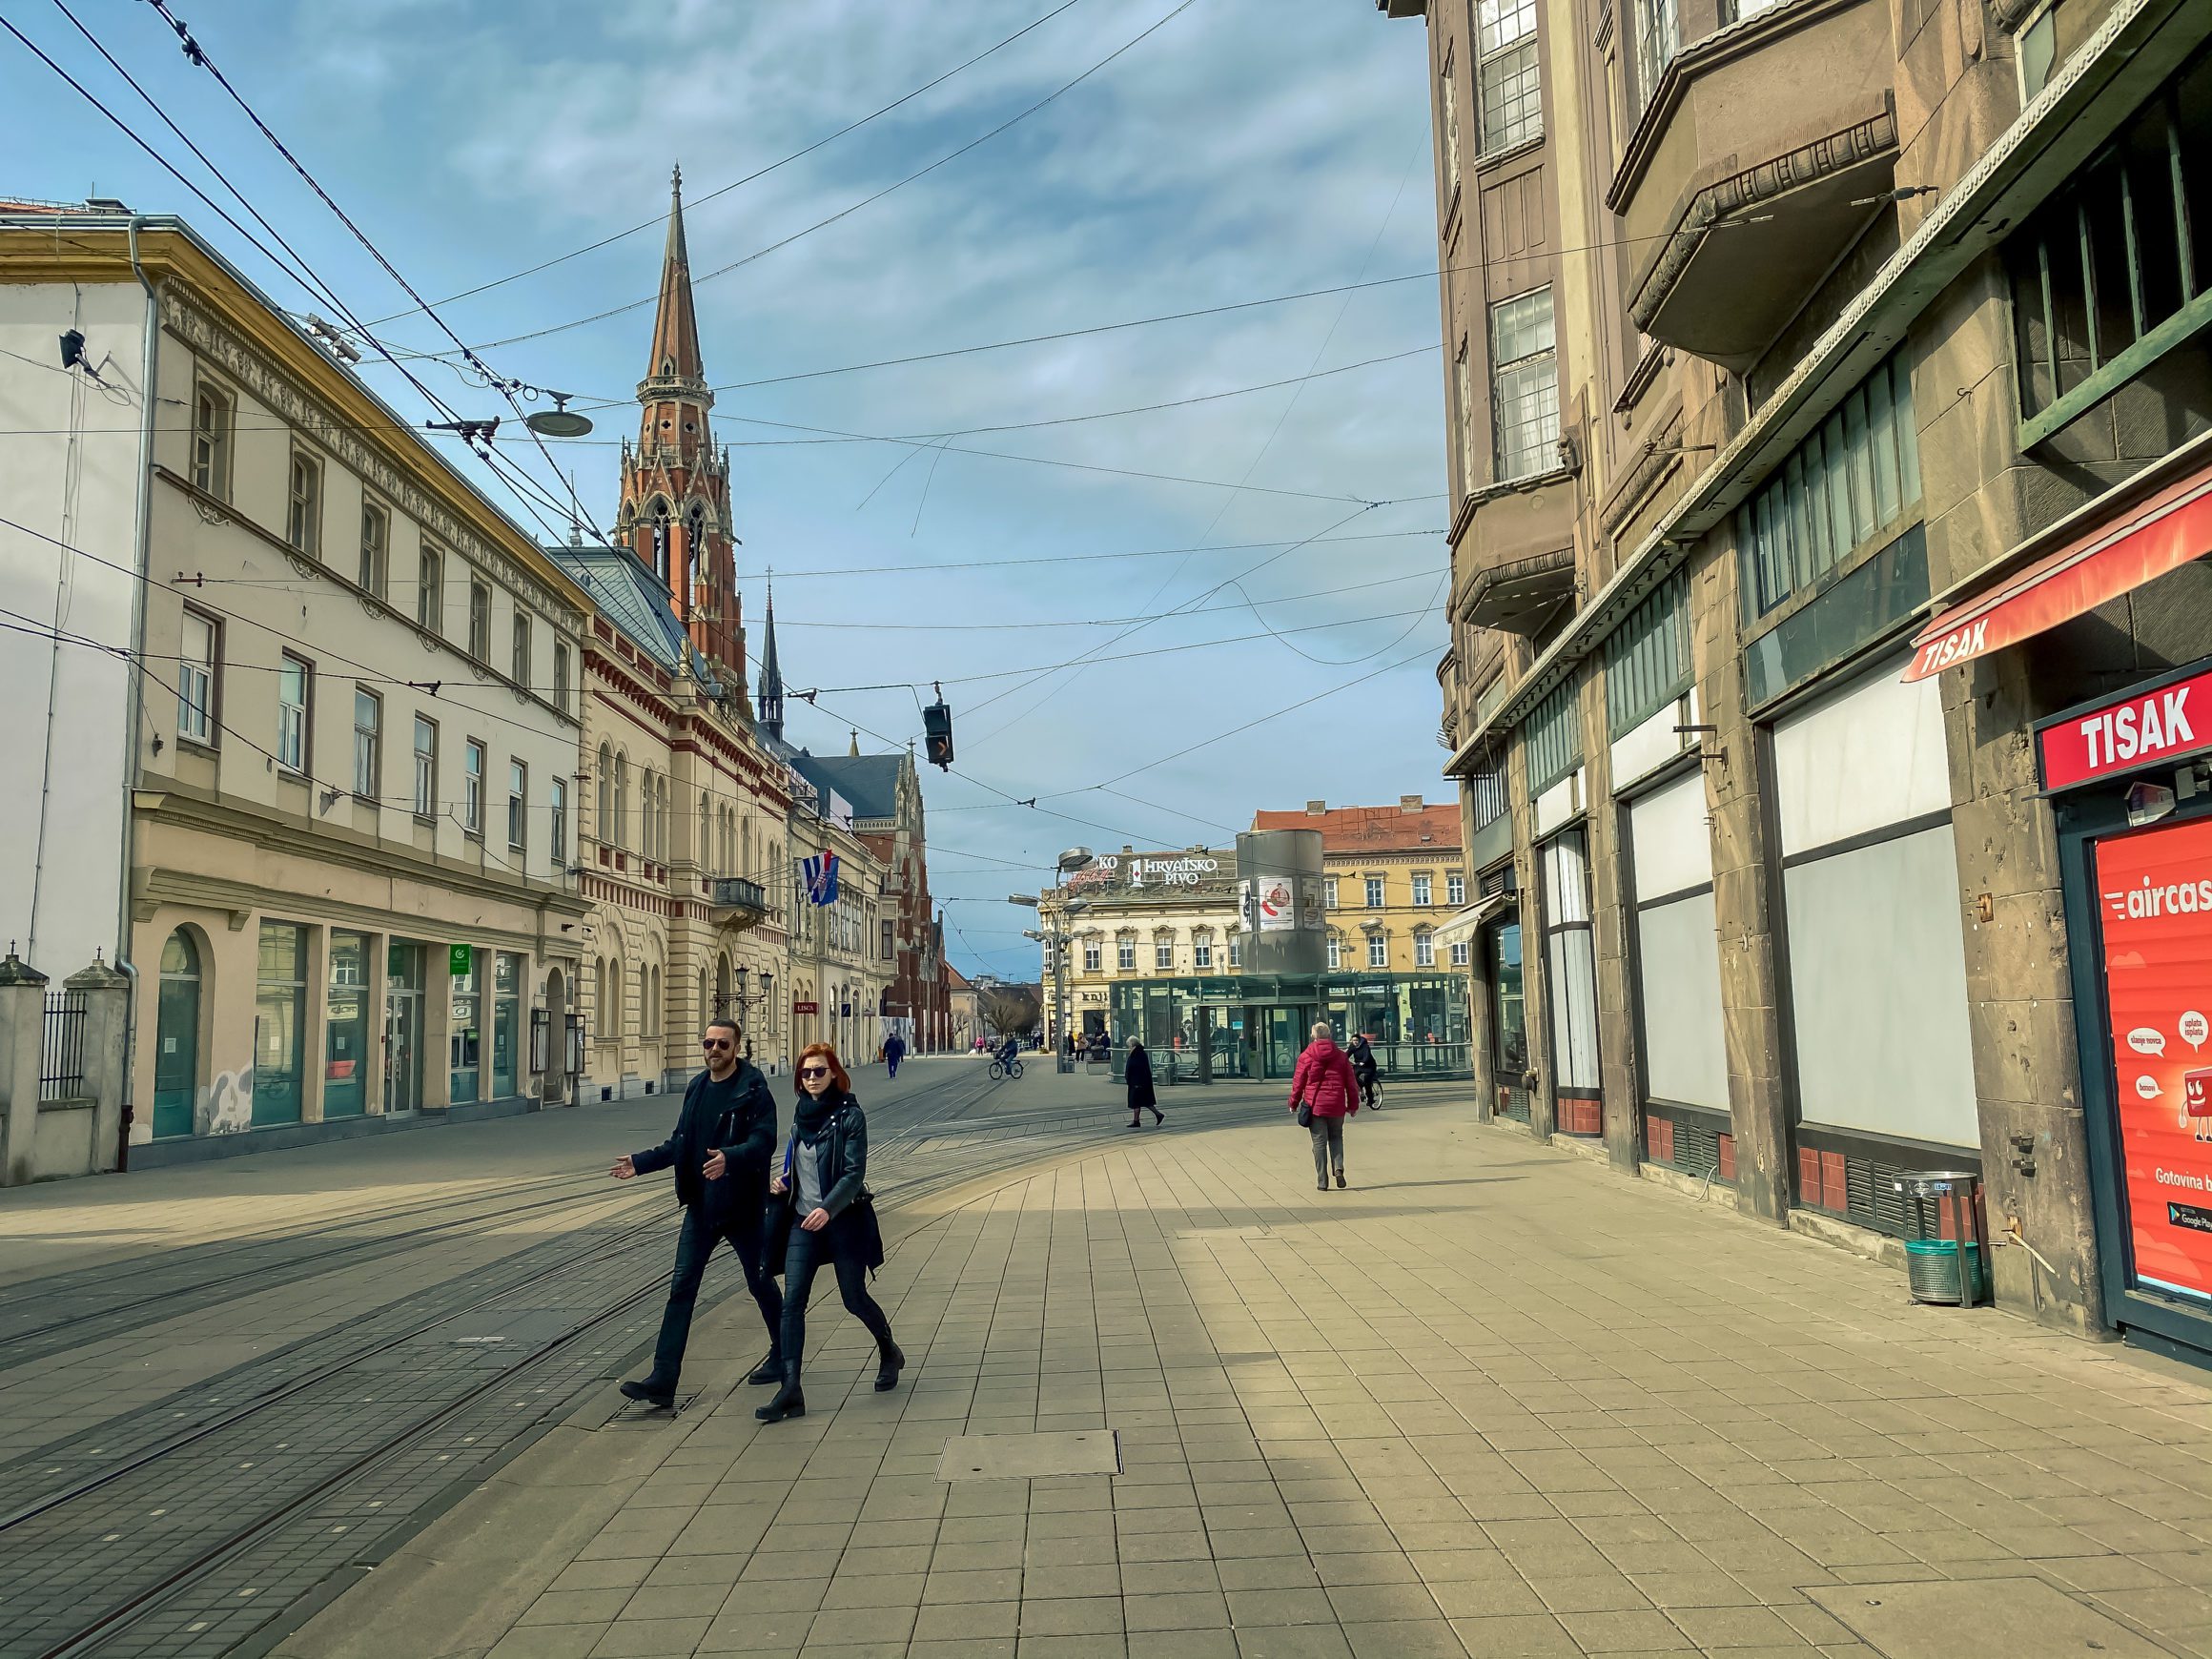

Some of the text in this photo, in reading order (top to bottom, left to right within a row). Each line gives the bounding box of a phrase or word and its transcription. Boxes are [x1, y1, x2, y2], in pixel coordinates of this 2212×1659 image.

[1921, 618, 1989, 673] TISAK
[2081, 686, 2195, 768] TISAK
[1144, 857, 1218, 873] HRVATSKO
[1164, 872, 1198, 886] PIVO
[2184, 1018, 2202, 1029] uplata
[2155, 1167, 2203, 1191] Gotovina
[2181, 1214, 2202, 1228] Google
